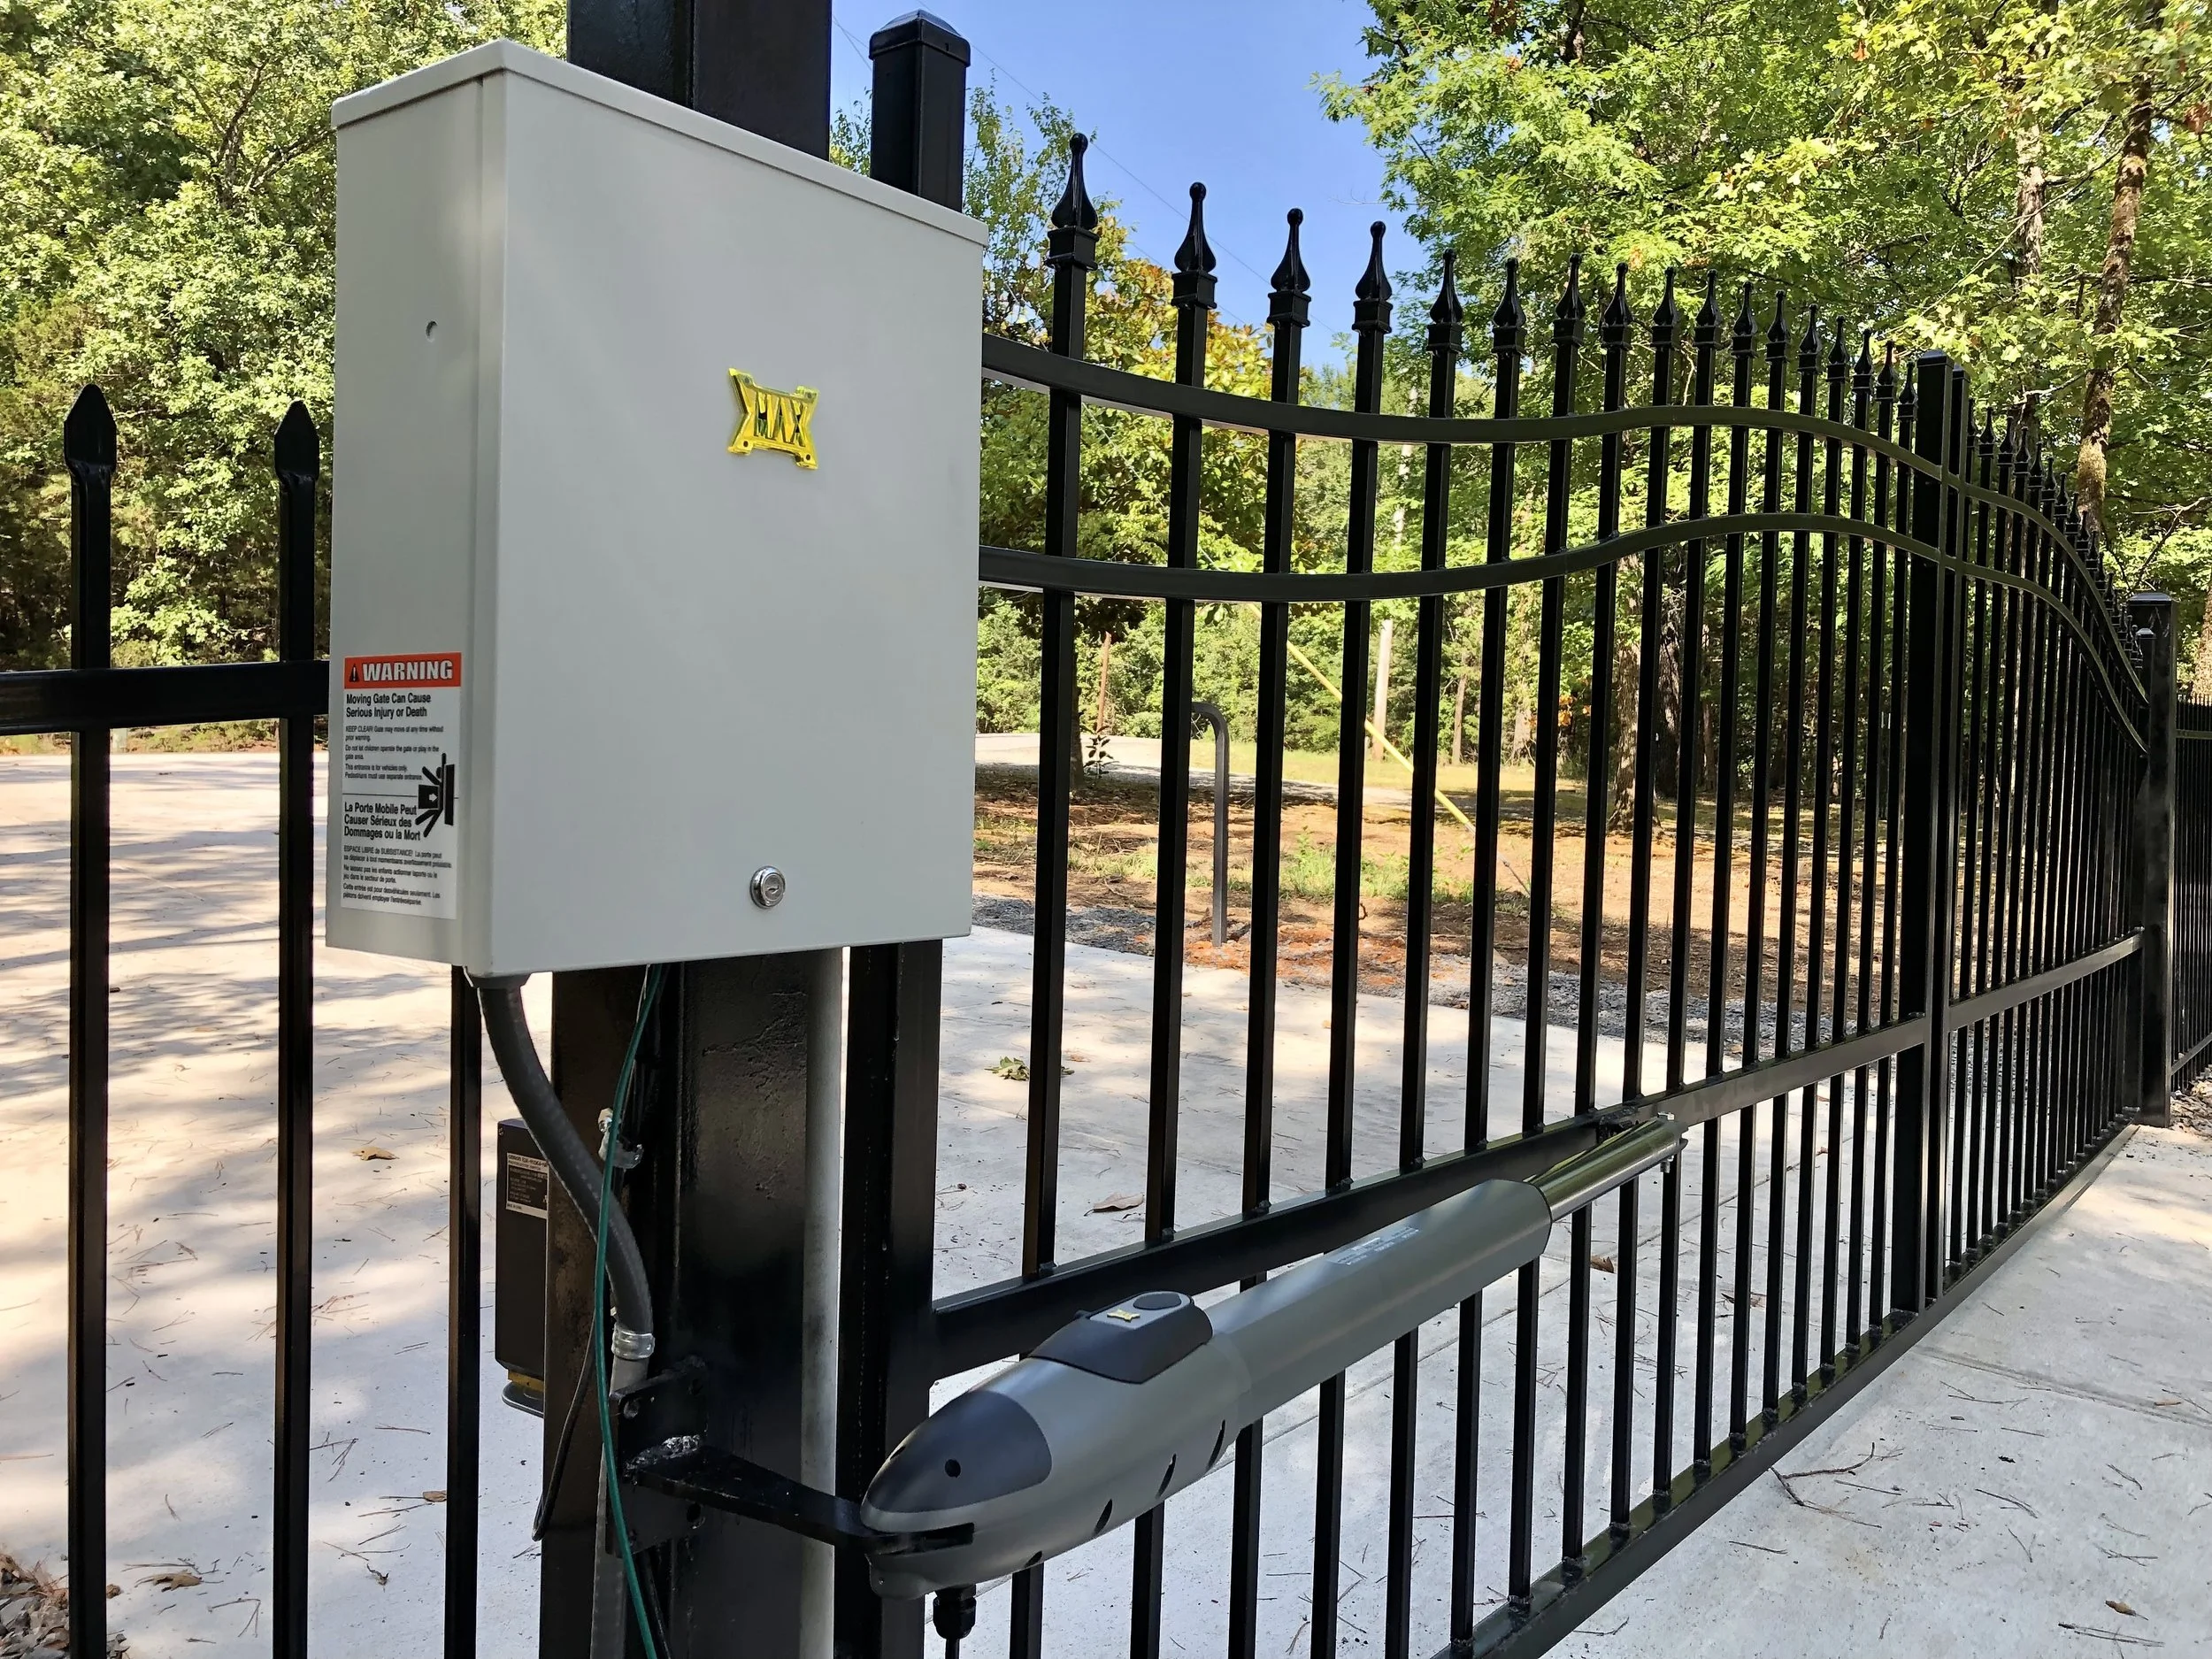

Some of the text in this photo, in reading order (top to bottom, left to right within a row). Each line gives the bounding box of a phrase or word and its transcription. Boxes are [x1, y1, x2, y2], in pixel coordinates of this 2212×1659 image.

[741, 380, 816, 456] MAX
[363, 660, 453, 681] WARNING
[346, 693, 431, 706] Moving Gate Can Cause
[346, 707, 373, 718] Serious
[373, 707, 395, 719] Injury
[406, 706, 427, 717] Death
[344, 802, 417, 815] La Porte Mobile Peut
[344, 814, 411, 827] Causer Sérieux des
[343, 826, 420, 841] Dommages ou la Mort
